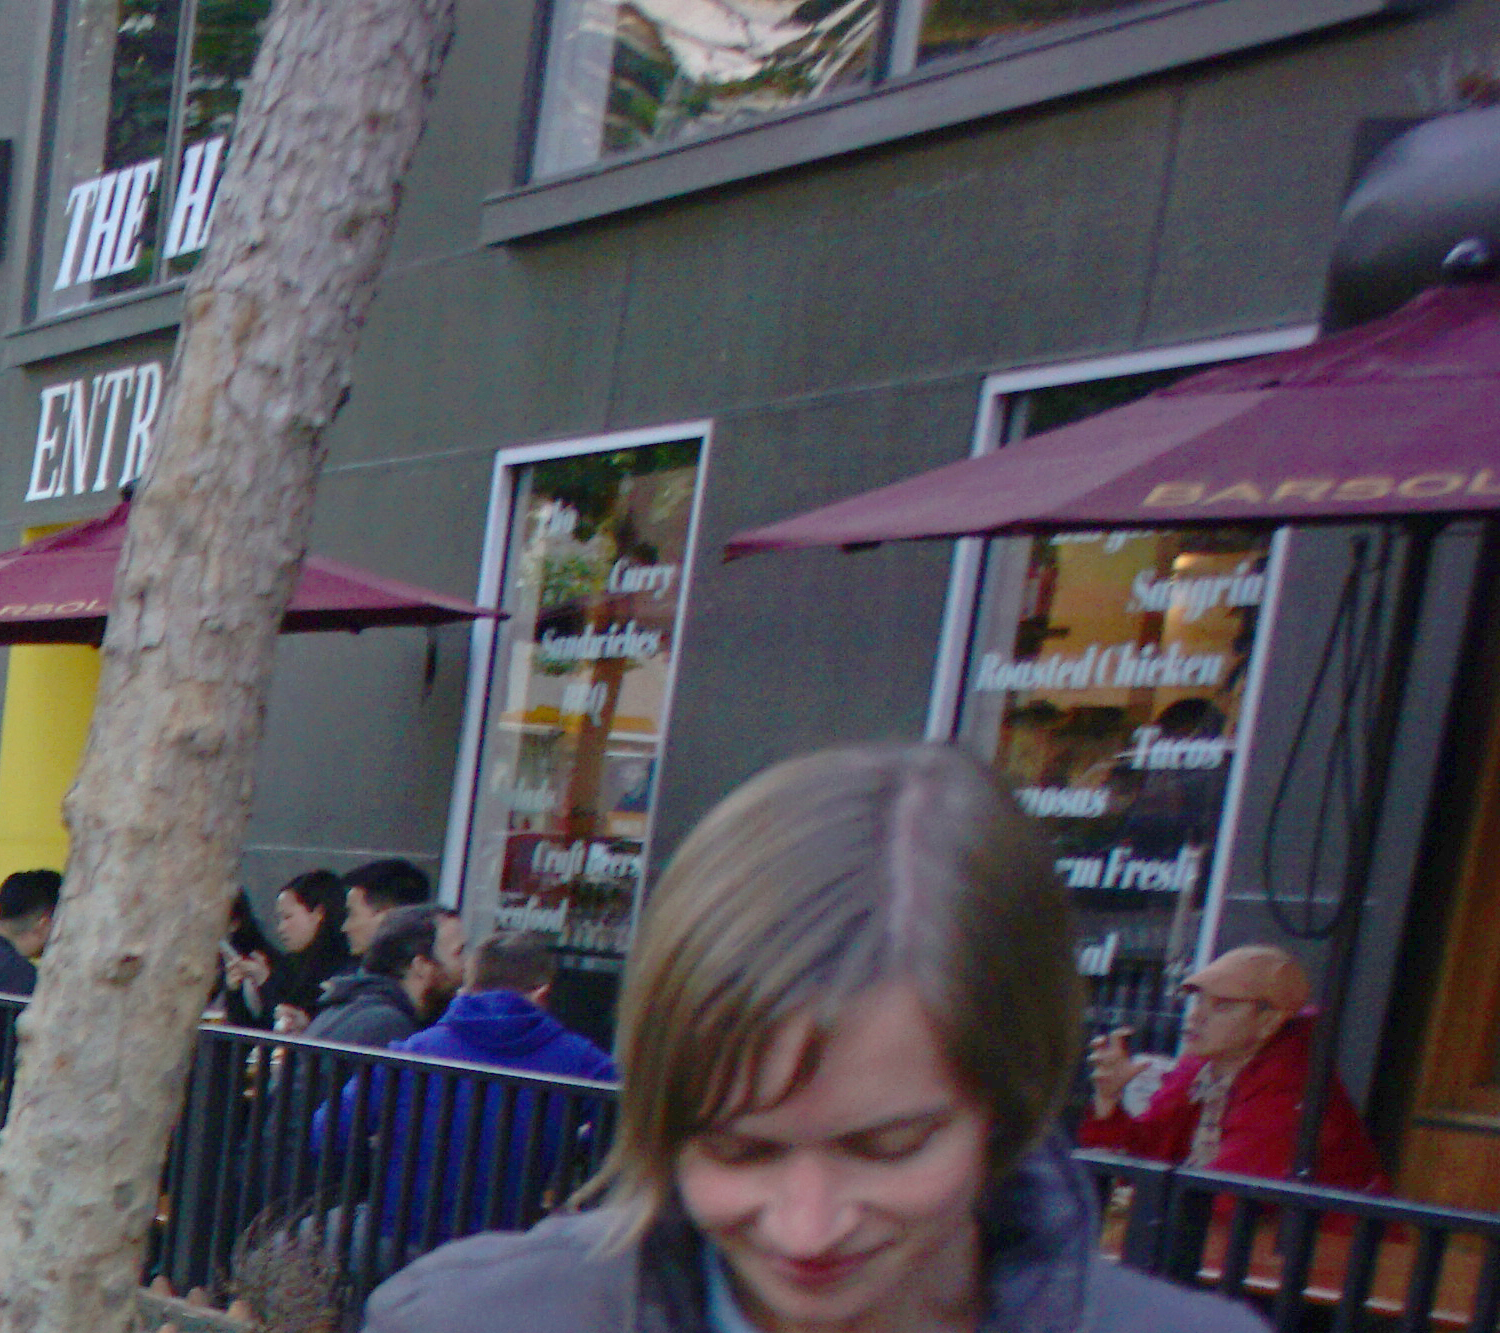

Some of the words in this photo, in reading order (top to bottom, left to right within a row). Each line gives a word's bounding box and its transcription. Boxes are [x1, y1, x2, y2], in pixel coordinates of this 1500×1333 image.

[53, 158, 162, 291] THE
[163, 134, 225, 261] H
[24, 361, 162, 502] ENTR
[607, 556, 677, 600] Curry
[973, 645, 1098, 691] Roasted
[1095, 640, 1224, 688] Chicken
[1131, 725, 1228, 771] Tacos
[531, 839, 585, 884] Craft
[1100, 845, 1202, 892] Fresh
[494, 893, 570, 932] eafood
